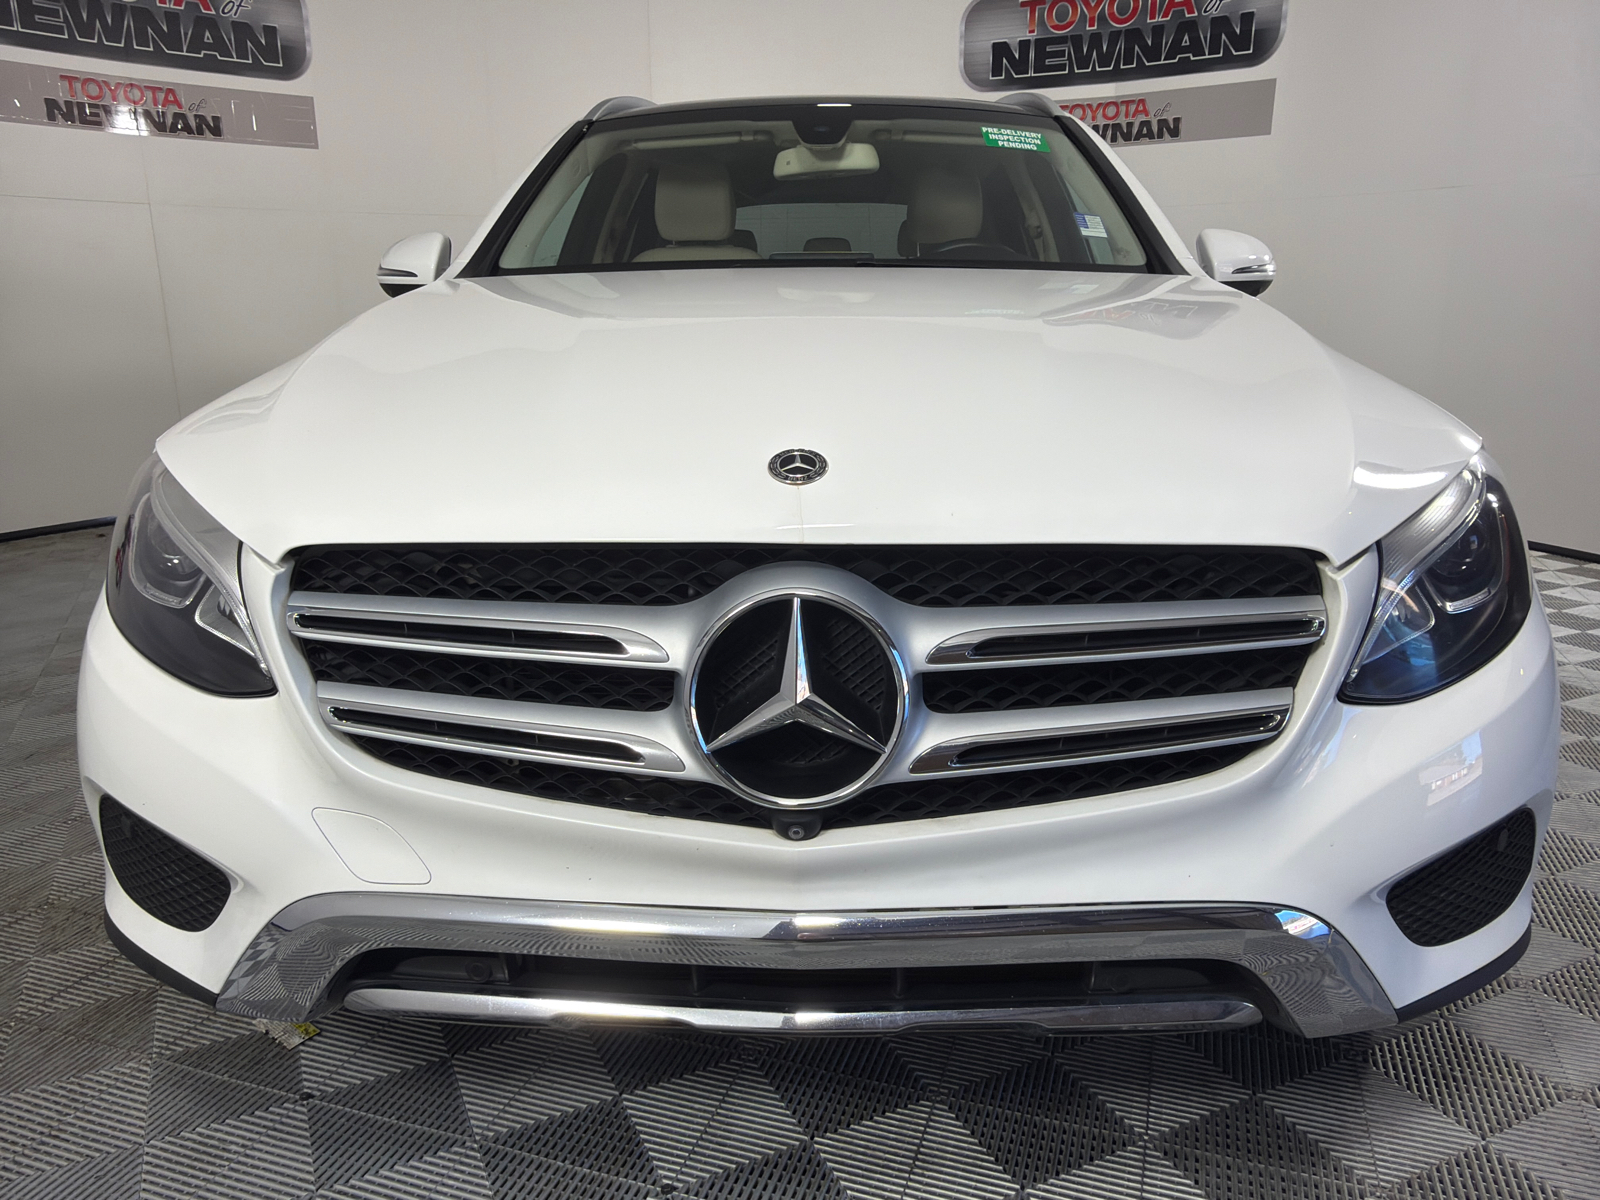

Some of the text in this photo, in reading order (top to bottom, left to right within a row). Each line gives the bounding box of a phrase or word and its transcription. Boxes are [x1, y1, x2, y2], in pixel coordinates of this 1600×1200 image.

[989, 10, 1256, 80] NEWNAN
[59, 74, 207, 113] TOYOTA of
[43, 97, 223, 138] NENAN
[1153, 102, 1171, 118] of
[981, 126, 1042, 139] PRE-DELIVERY
[988, 133, 1042, 145] INSPECTION
[1091, 116, 1182, 143] NAN
[998, 140, 1037, 150] PENDING
